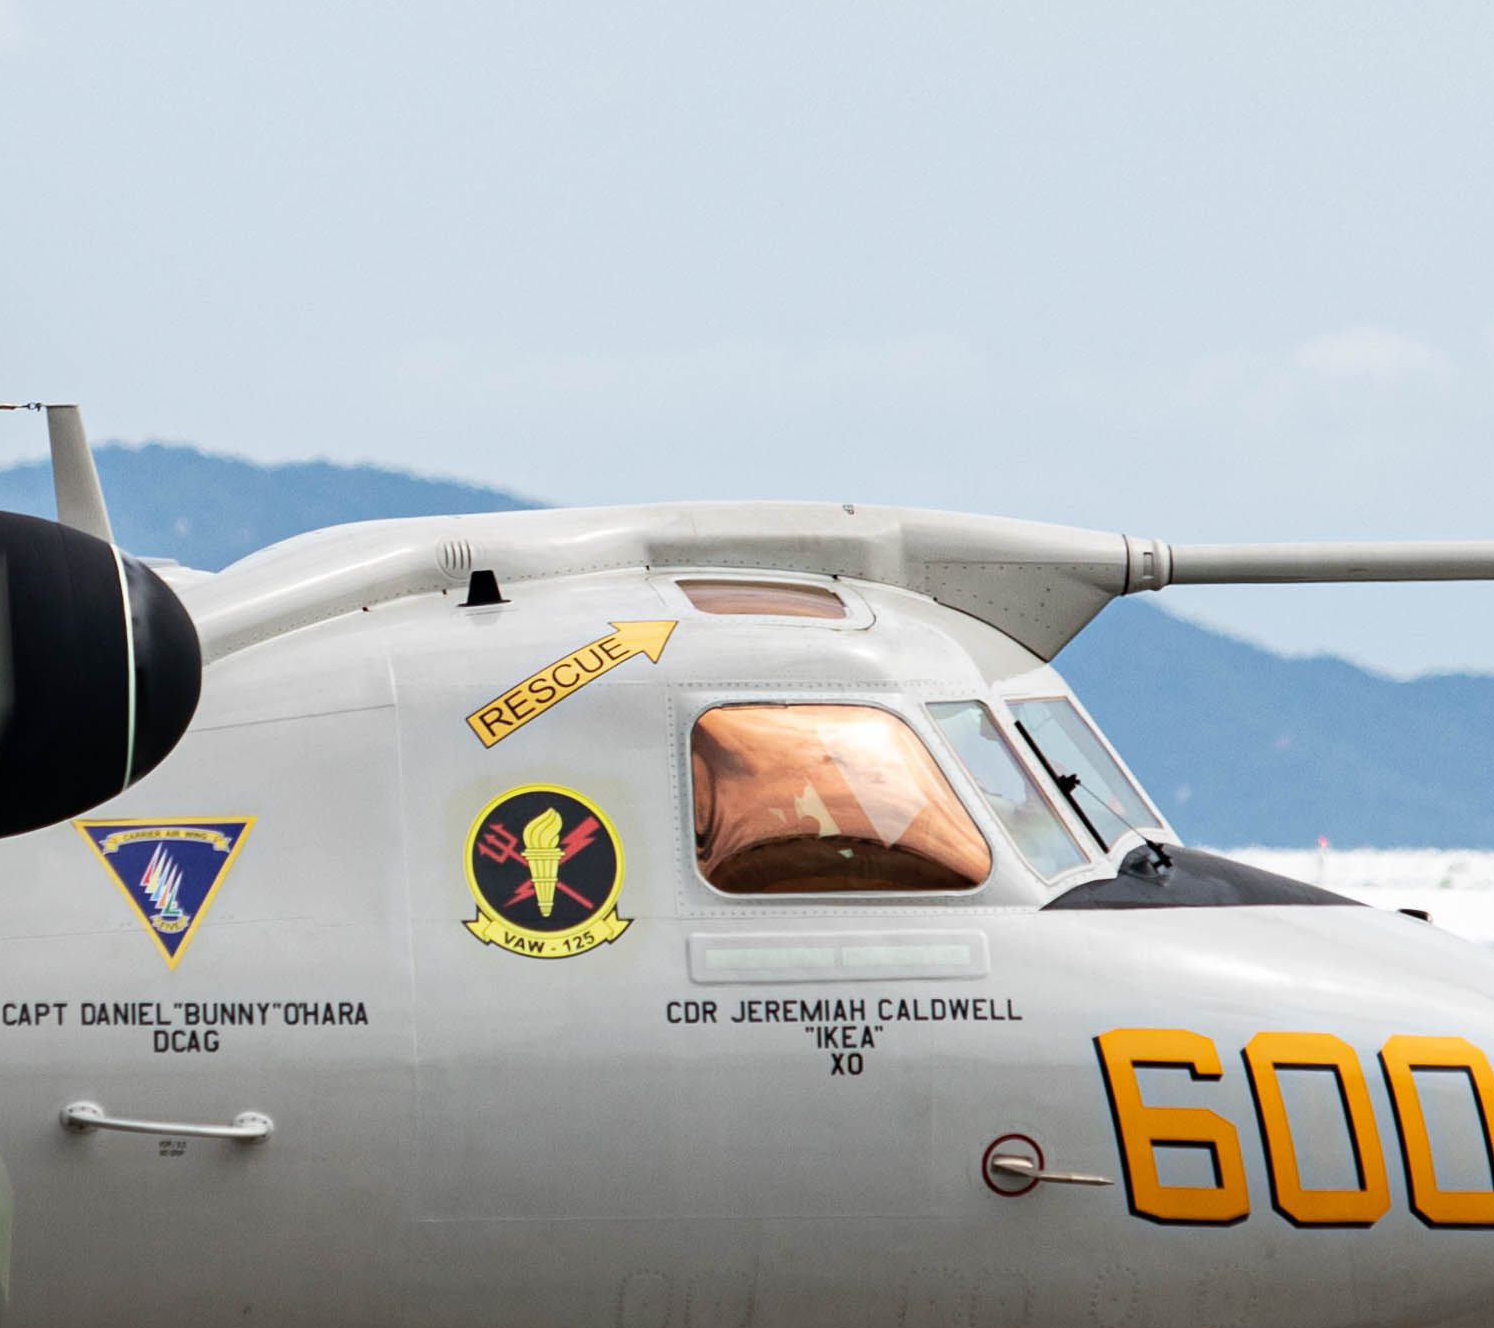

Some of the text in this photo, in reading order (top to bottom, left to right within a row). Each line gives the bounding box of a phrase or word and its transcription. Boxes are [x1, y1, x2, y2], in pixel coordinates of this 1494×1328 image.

[479, 637, 631, 738] RESCUE
[503, 931, 545, 953] VAW
[562, 931, 596, 952] 125
[1, 1002, 68, 1027] CAPT
[80, 1002, 171, 1026] DANIEL
[666, 998, 1023, 1023] CDR JEREMIAH CALDWELL
[153, 1029, 220, 1053] DCAG
[804, 1025, 885, 1049] "IKEA"
[829, 1052, 864, 1076] XO
